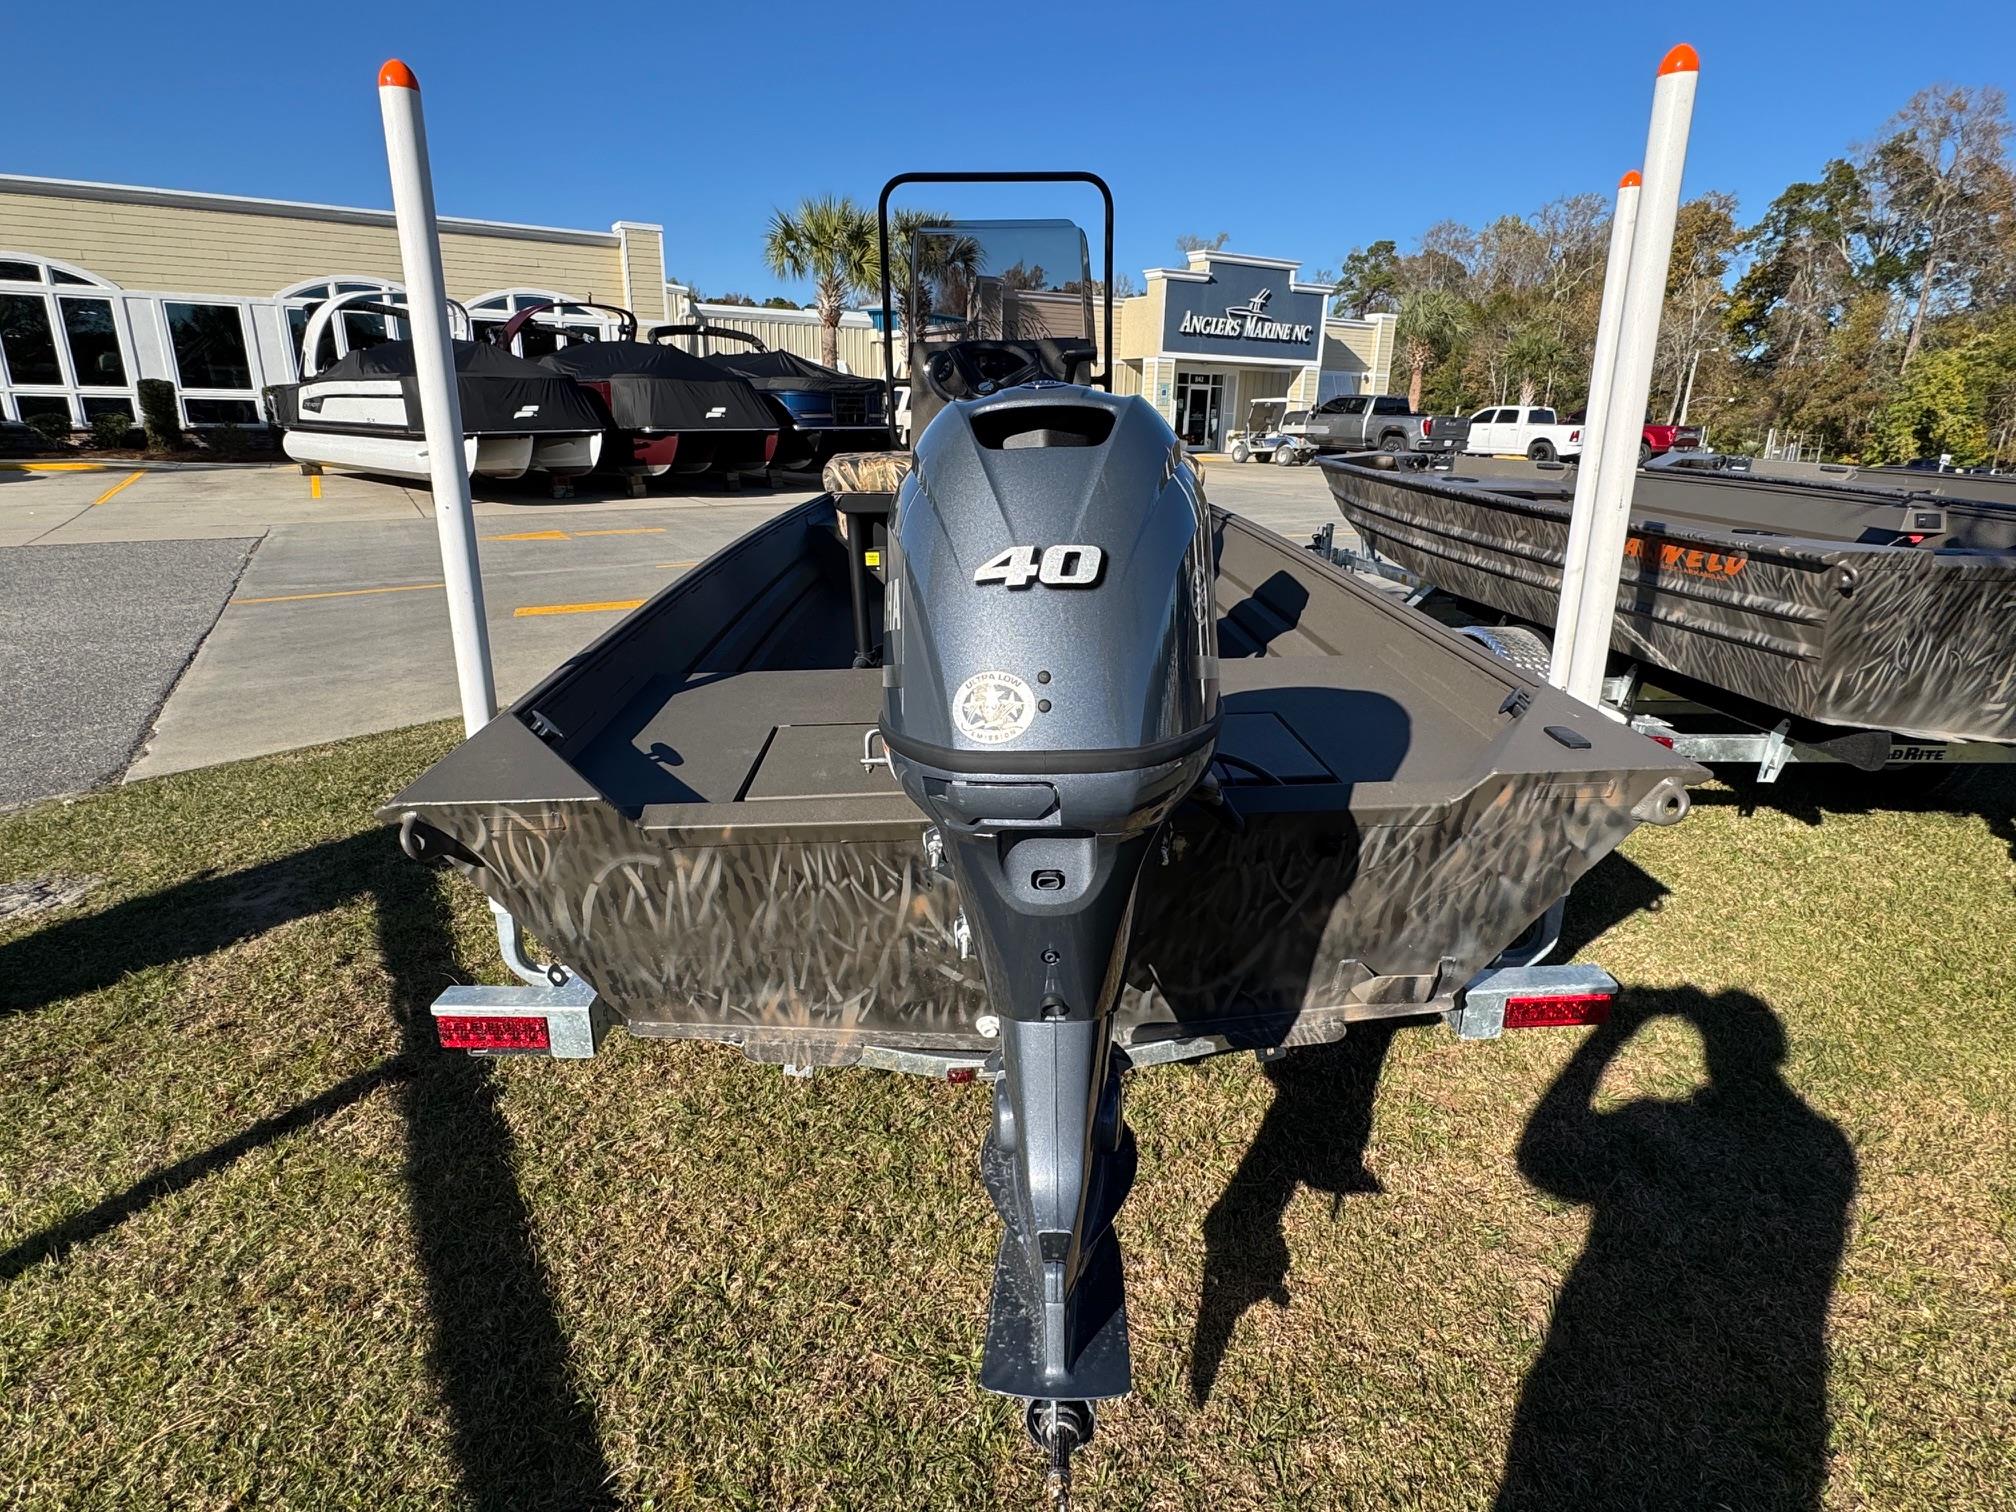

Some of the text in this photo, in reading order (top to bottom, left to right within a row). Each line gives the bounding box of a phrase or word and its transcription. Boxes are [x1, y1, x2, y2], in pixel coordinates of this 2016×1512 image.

[1179, 310, 1313, 342] ANGLERS MARINE NC
[973, 545, 1102, 587] 40
[1623, 537, 1748, 576] AWELD
[884, 578, 901, 632] HA
[965, 673, 1022, 690] ULTRA LOW
